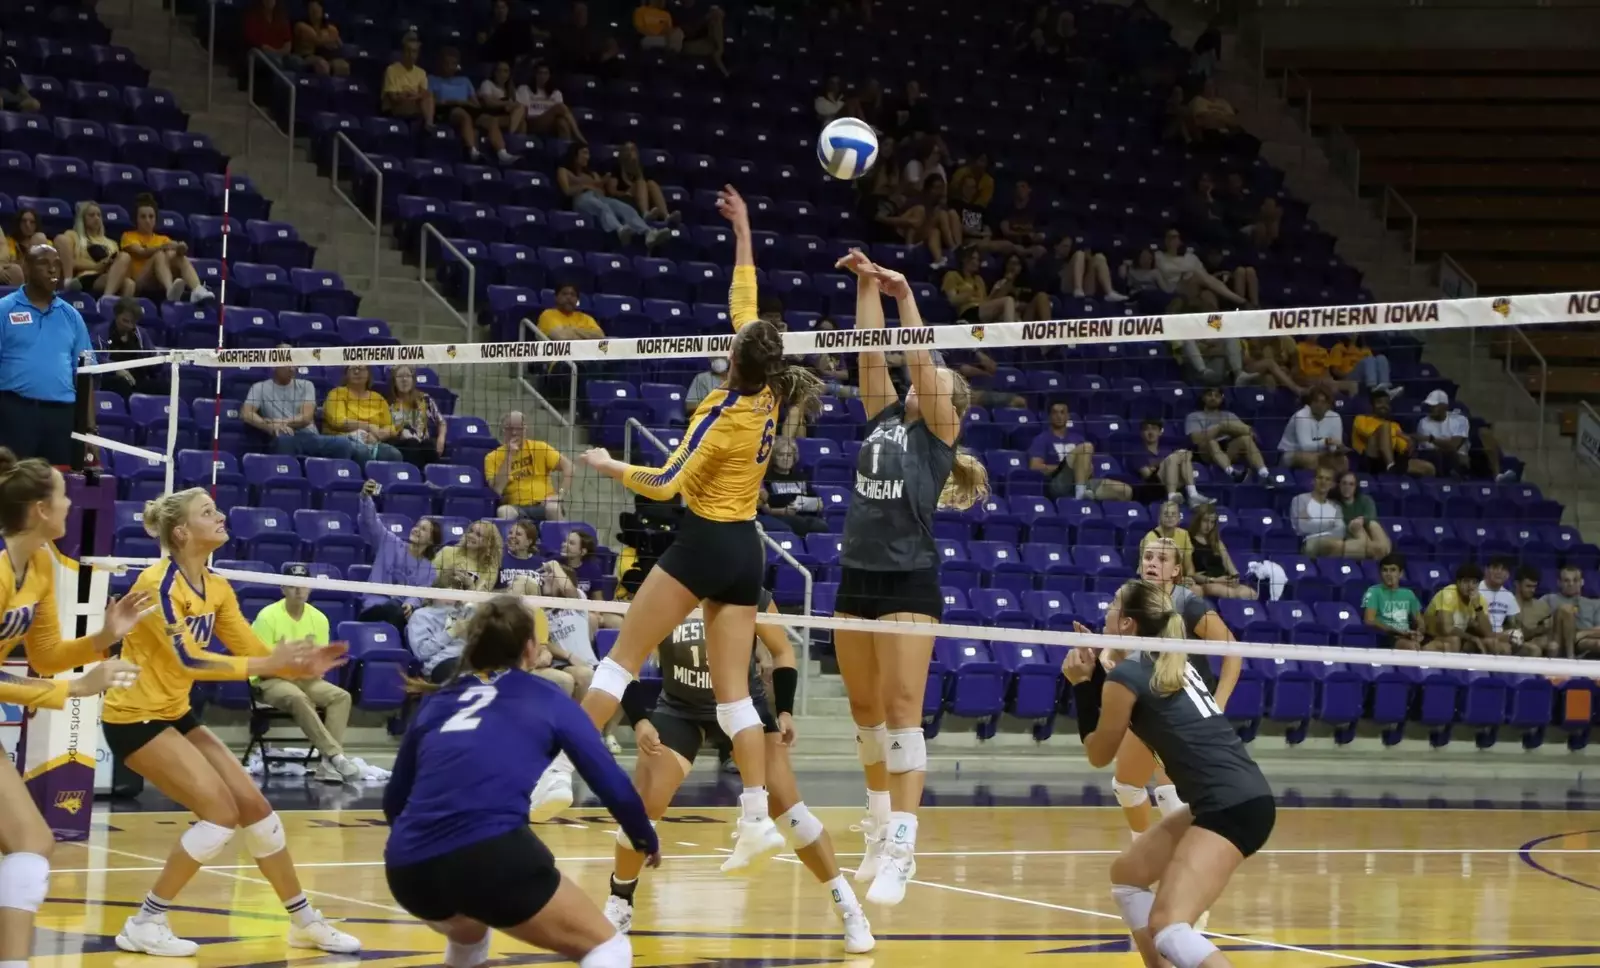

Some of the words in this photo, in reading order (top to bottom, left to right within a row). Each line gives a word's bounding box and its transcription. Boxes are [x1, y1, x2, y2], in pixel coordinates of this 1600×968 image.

[1268, 305, 1377, 330] NORTHERN
[1384, 302, 1439, 323] IOWA
[815, 329, 891, 348] NORTHERN
[897, 327, 935, 345] IOWA
[1022, 319, 1112, 340] NORTHERN
[1119, 317, 1164, 337] IOWA
[218, 349, 266, 363] NORTHERN
[269, 350, 292, 363] IOWA
[343, 347, 394, 361] NORTHERN
[398, 346, 425, 360] IOWA
[481, 343, 538, 358] NORTHERN
[543, 342, 571, 357] IOWA
[637, 337, 703, 354] NORTHERN
[708, 336, 733, 352] IOW
[756, 418, 774, 464] 6
[872, 443, 881, 474] 1
[673, 622, 706, 643] WEST
[674, 665, 713, 689] MICHI
[440, 685, 498, 732] 2
